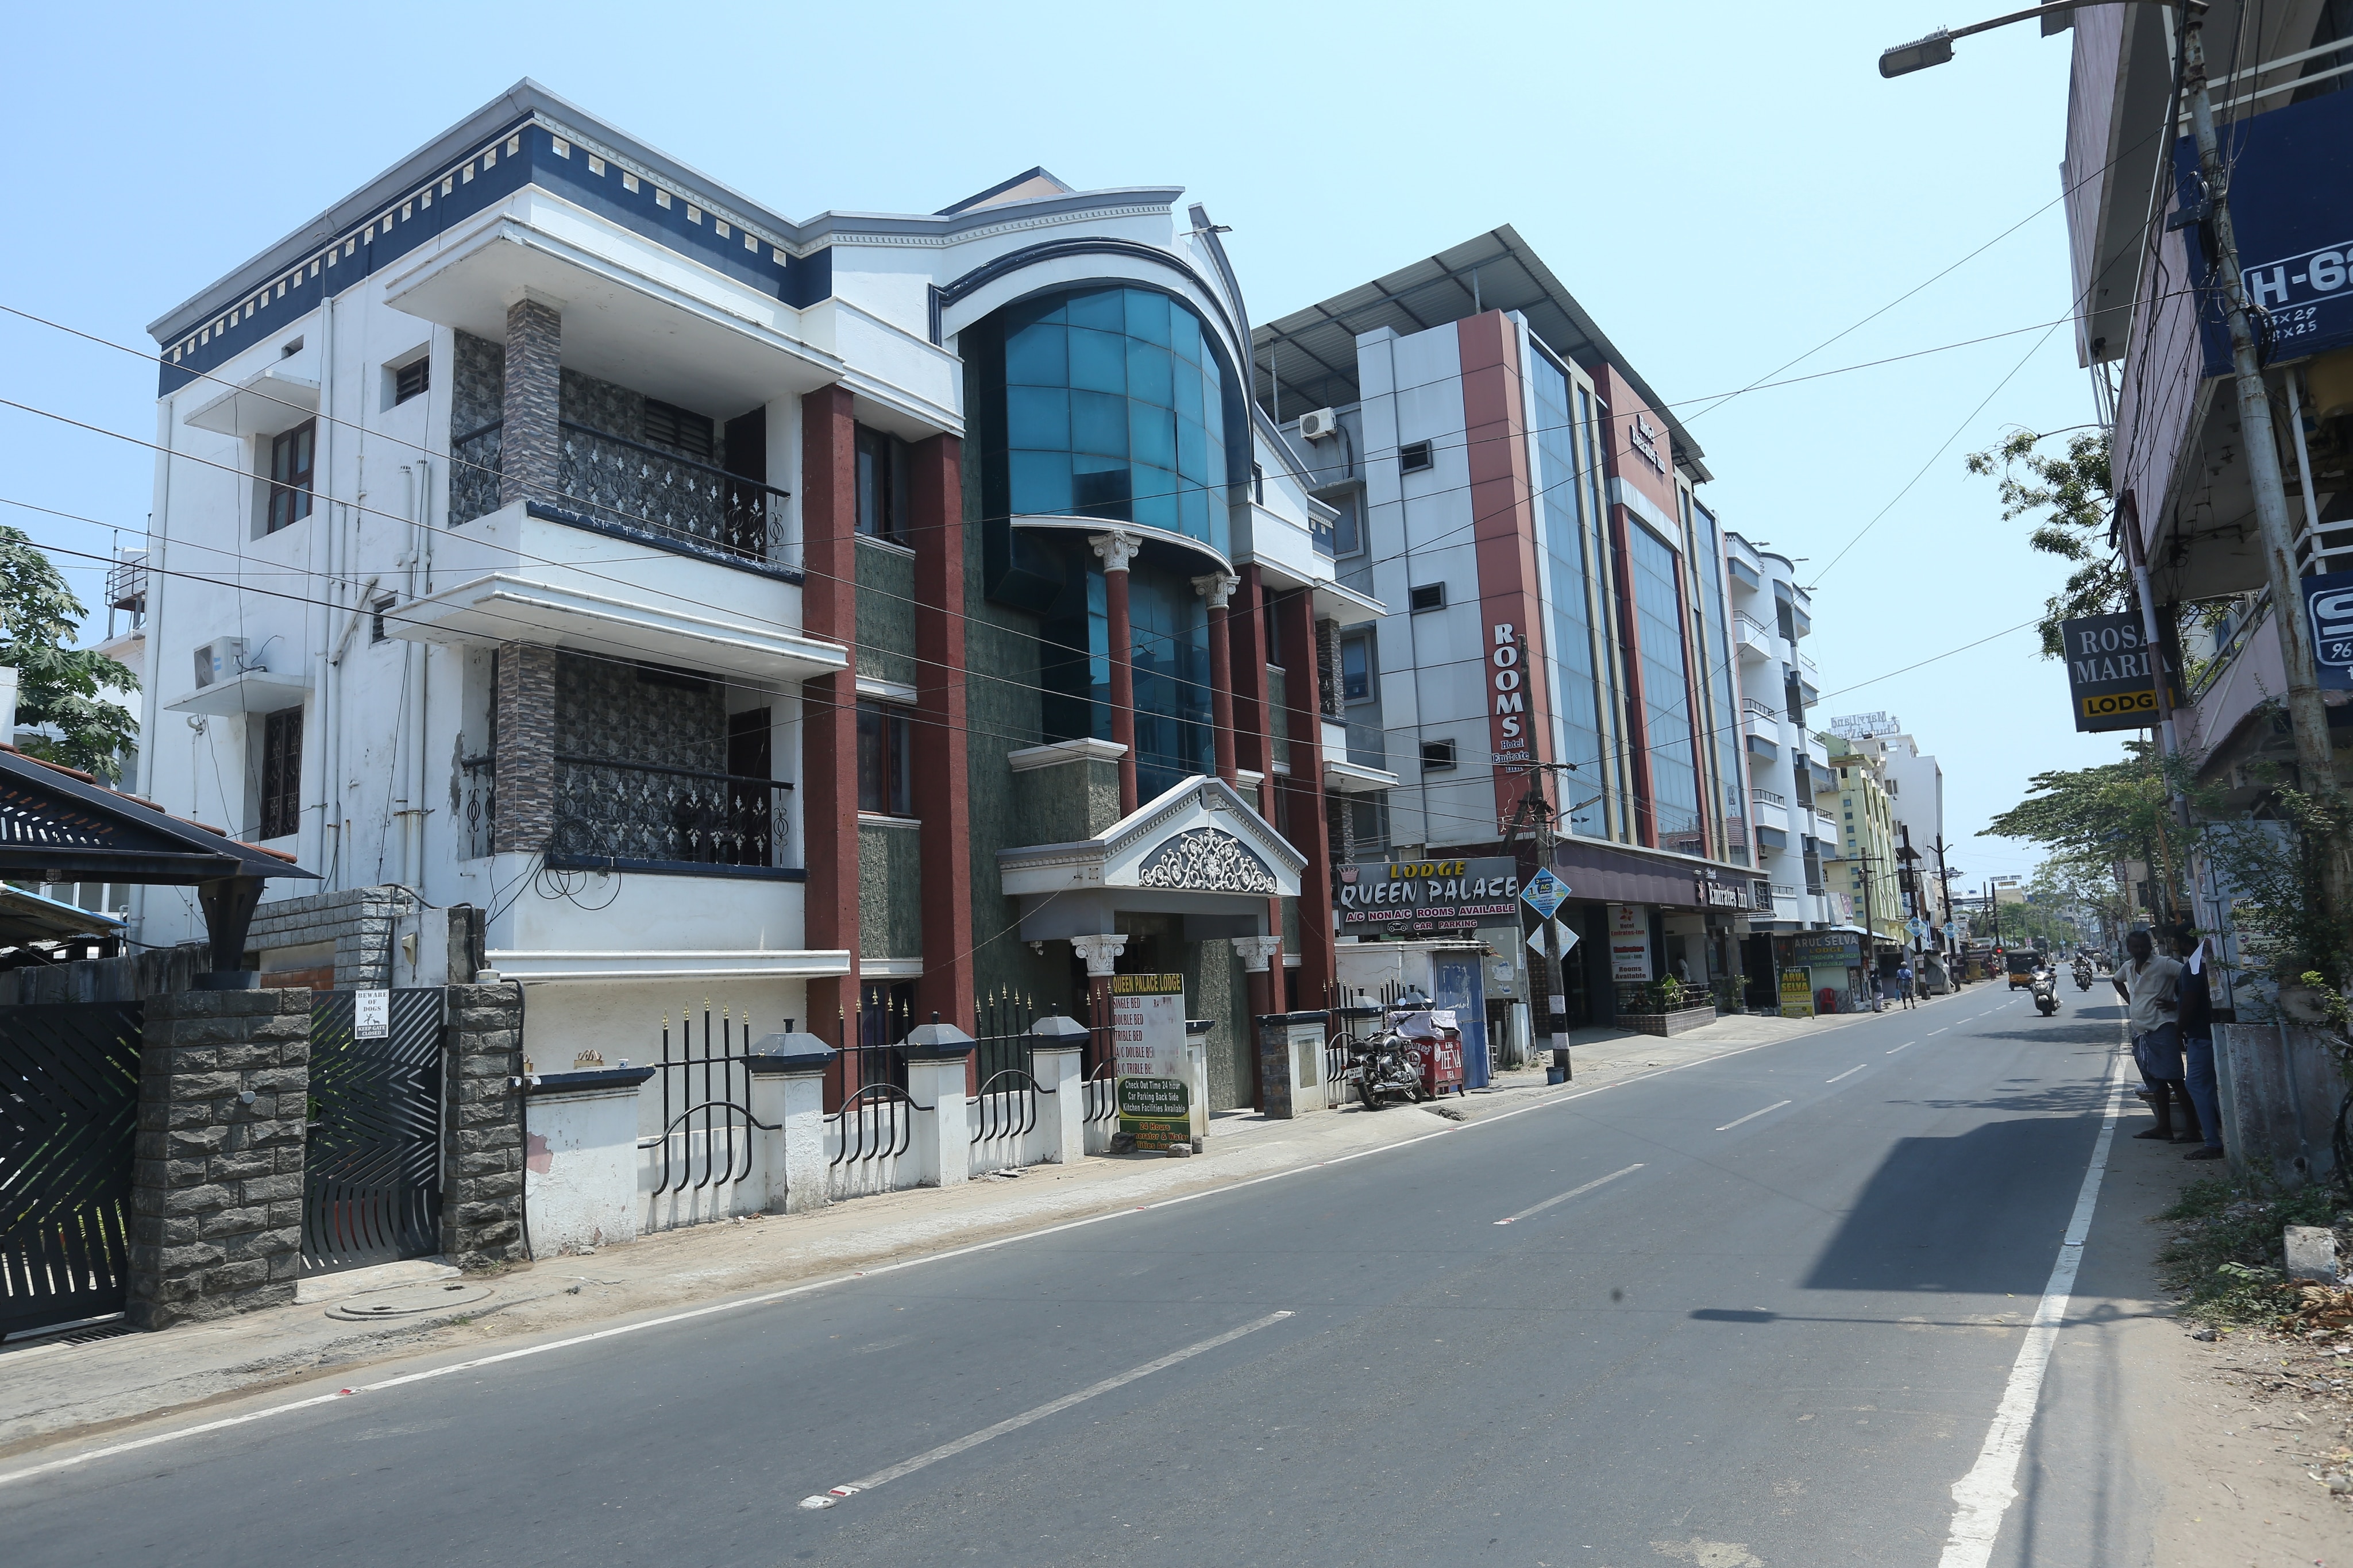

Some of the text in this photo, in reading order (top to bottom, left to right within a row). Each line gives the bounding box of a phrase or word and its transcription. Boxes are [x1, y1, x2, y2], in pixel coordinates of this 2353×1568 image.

[2251, 247, 2353, 306] H-6
[1637, 414, 1654, 445] Hotel
[1630, 424, 1657, 465] Emirates
[1494, 623, 1525, 738] ROOMS
[2087, 693, 2159, 715] LODG
[1500, 738, 1524, 750] Hotel
[1390, 861, 1465, 878] LODGE
[1340, 876, 1517, 909] QUEEN PALACE
[1707, 882, 1737, 907] Emirates
[1345, 912, 1365, 922] A/C
[1368, 910, 1392, 921] NON
[1416, 906, 1455, 918] ROOMS
[1458, 903, 1516, 917] AVAILABLE
[1413, 920, 1478, 930] CAR PARKING
[1795, 935, 1858, 948] ARUL SELVA
[1782, 972, 1807, 982] ARUL
[1113, 974, 1181, 993] QUEEN PALACE LODGE
[1781, 982, 1809, 992] SELVA
[1113, 997, 1130, 1009] SINGLE
[1131, 997, 1140, 1009] BED
[1114, 1014, 1144, 1025] DOUBLE BED
[1114, 1030, 1143, 1041] TRIBLE BED
[1126, 1046, 1144, 1058] DOUBLE
[1127, 1063, 1144, 1075] TRIBLE
[1446, 1071, 1455, 1079] TEA
[1125, 1080, 1139, 1089] Check
[1140, 1081, 1148, 1090] Out
[1149, 1081, 1161, 1090] Time
[1162, 1081, 1168, 1090] 24
[1137, 1092, 1154, 1103] Parking
[1155, 1092, 1168, 1101] Back
[1168, 1093, 1179, 1101] Side
[1123, 1103, 1186, 1113] Kitchen Facilities Available
[1139, 1122, 1170, 1130] 24 Hours
[1161, 1132, 1167, 1140] &
[1168, 1132, 1189, 1141] Water
